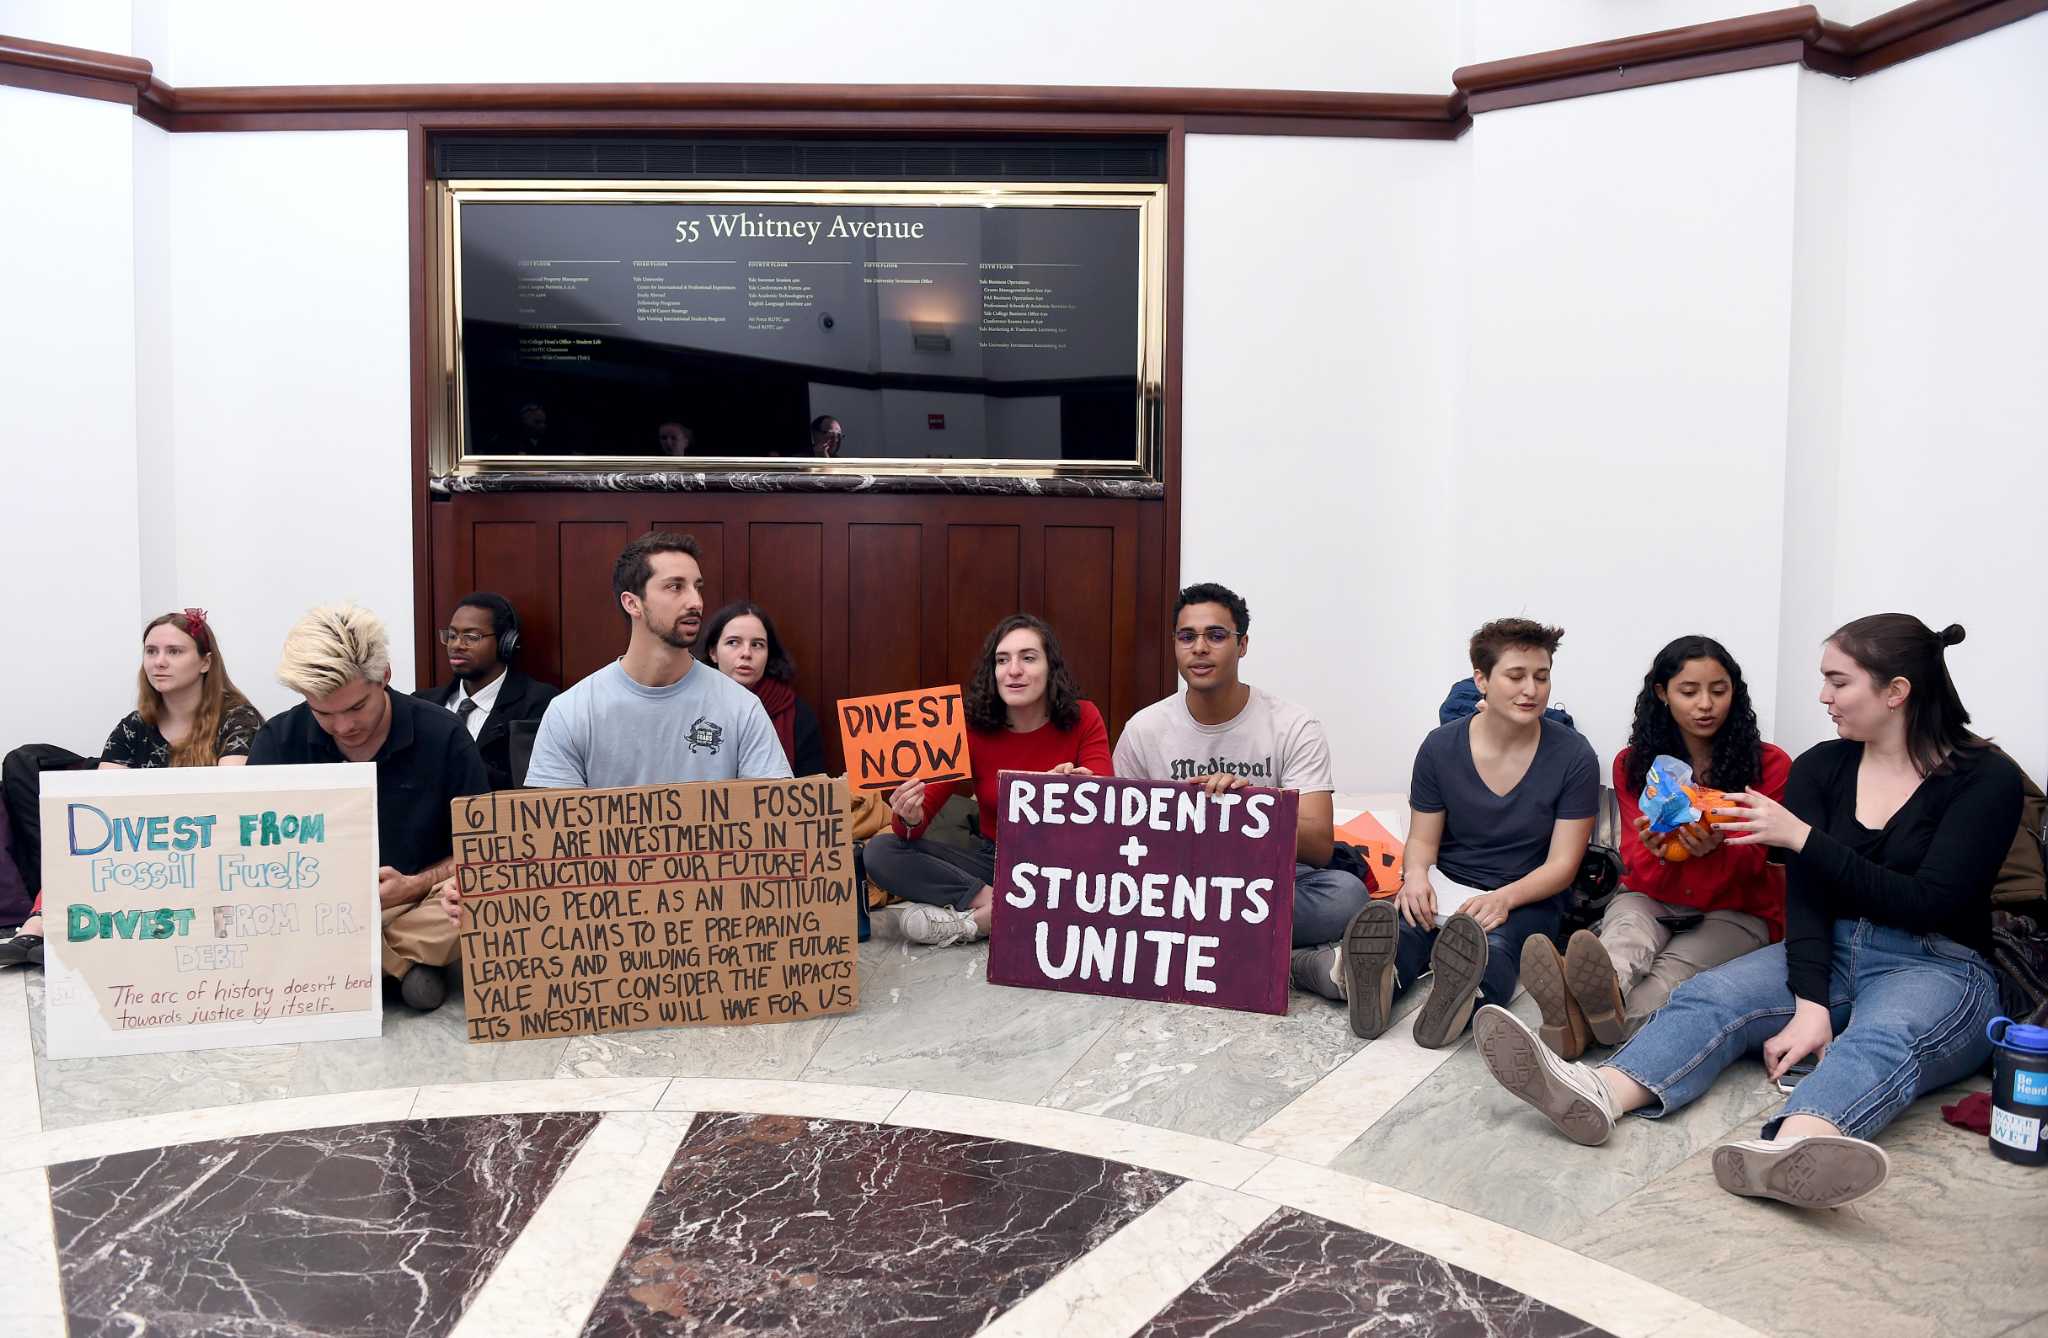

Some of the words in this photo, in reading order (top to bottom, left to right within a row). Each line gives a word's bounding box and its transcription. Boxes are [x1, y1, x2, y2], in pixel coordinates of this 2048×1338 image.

[675, 220, 700, 243] 55
[707, 211, 822, 246] Whitney
[829, 214, 925, 240] Avenue
[843, 695, 960, 737] DIVEST
[860, 733, 961, 779] NOW
[1171, 757, 1272, 780] Medieval
[511, 789, 682, 831] INVESTMENTS
[702, 786, 729, 820] IN
[754, 783, 842, 819] FOSSIL
[1008, 780, 1276, 839] RESIDENTS
[68, 803, 216, 856] DIVEST
[240, 811, 325, 847] FROM
[462, 833, 536, 863] FUELS
[553, 830, 592, 858] ARE
[600, 821, 752, 855] INVESTMENTS
[764, 822, 786, 848] IN
[795, 818, 846, 848] THE
[1119, 836, 1148, 866] +
[91, 851, 195, 892] Fossil
[218, 851, 320, 891] Fuels
[460, 860, 616, 893] DESTRUCTION
[628, 858, 655, 882] OF
[664, 856, 709, 880] OUR
[719, 851, 804, 877] FUTURE
[809, 850, 842, 874] AS
[1005, 862, 1274, 925] STUDENTS
[67, 903, 195, 942] DIVEST
[213, 903, 299, 939] FROM
[315, 903, 365, 936] P.R.
[464, 895, 550, 929] YOUNG
[564, 889, 648, 921] PEOPLE.
[657, 889, 684, 913] AS
[695, 885, 724, 911] AN
[741, 878, 852, 909] INSTITUTION
[175, 943, 248, 971] DEBT
[462, 928, 527, 958] THAT
[541, 924, 623, 950] CLAIMS
[627, 921, 655, 943] TO
[665, 920, 693, 946] BE
[705, 912, 820, 941] PREPARING
[1036, 921, 1220, 993] UNITE
[470, 955, 563, 985] LEADERS
[571, 954, 607, 977] AND
[620, 947, 700, 971] BUILDING
[708, 944, 739, 968] FOR
[743, 941, 776, 962] THE
[789, 936, 850, 959] FUTURE
[108, 984, 144, 1007] The
[151, 991, 177, 1004] arc
[187, 981, 207, 1001] of
[214, 979, 274, 1002] history
[284, 975, 337, 995] doesn't
[344, 975, 373, 990] bend
[474, 984, 531, 1014] YALE
[547, 978, 613, 1006] MUST
[617, 970, 724, 998] CONSIDER
[728, 966, 771, 990] THE
[783, 961, 852, 988] IMPACTS
[116, 1008, 182, 1029] towards
[187, 1007, 245, 1024] justice
[254, 1005, 272, 1024] by
[281, 998, 335, 1014] itself.
[469, 1015, 510, 1039] ITS
[521, 1003, 649, 1033] INVESTMENTS
[659, 1005, 708, 1023] WILL
[721, 998, 757, 1020] HAVE
[768, 991, 807, 1015] FOR
[2016, 1083, 2048, 1097] Heard
[2017, 1073, 2033, 1086] Be
